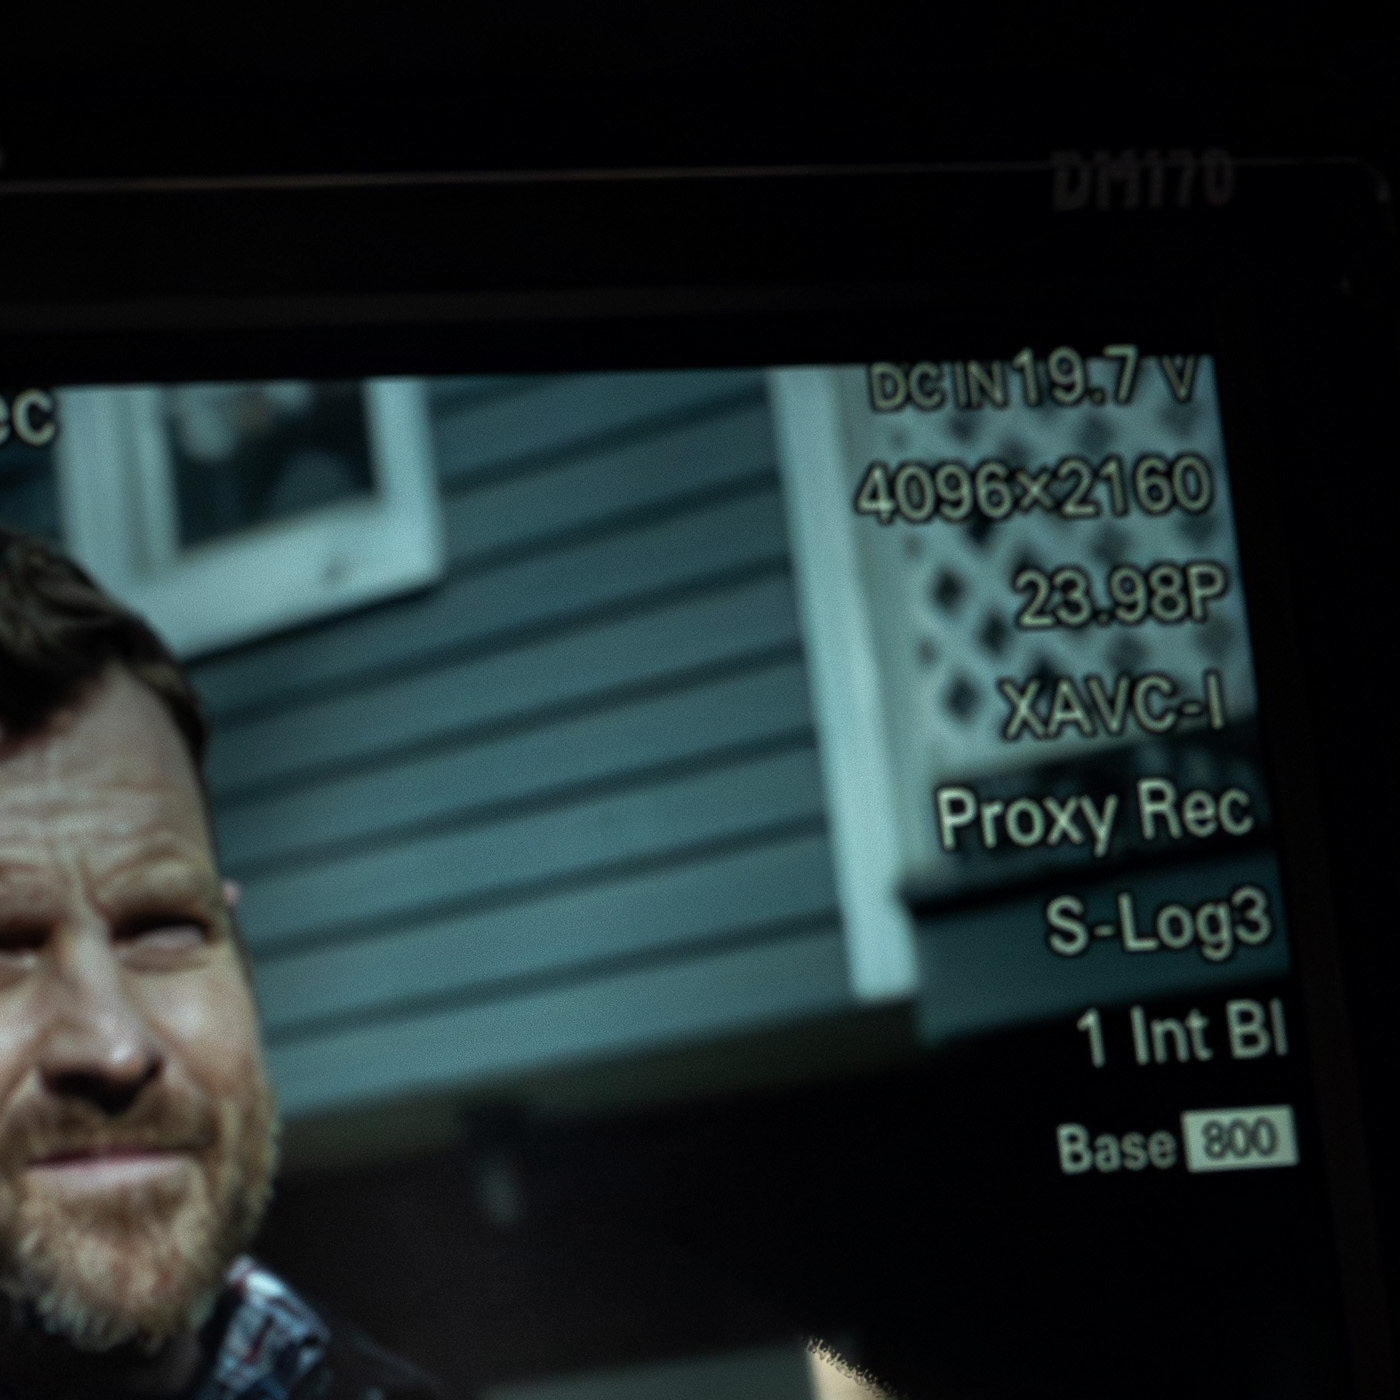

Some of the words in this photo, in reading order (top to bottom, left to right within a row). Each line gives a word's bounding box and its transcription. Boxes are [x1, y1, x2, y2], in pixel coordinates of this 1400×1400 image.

[1161, 354, 1200, 402] V
[1013, 562, 1227, 629] 23.98P
[1001, 671, 1226, 739] XAVC-I
[936, 785, 1118, 857] Proxy
[1136, 778, 1255, 841] Rec
[1045, 884, 1273, 962] S-Log3
[1075, 1006, 1107, 1069] 1
[1129, 1004, 1215, 1067] Int
[1056, 1121, 1178, 1176] Base
[1202, 1117, 1277, 1160] 800
